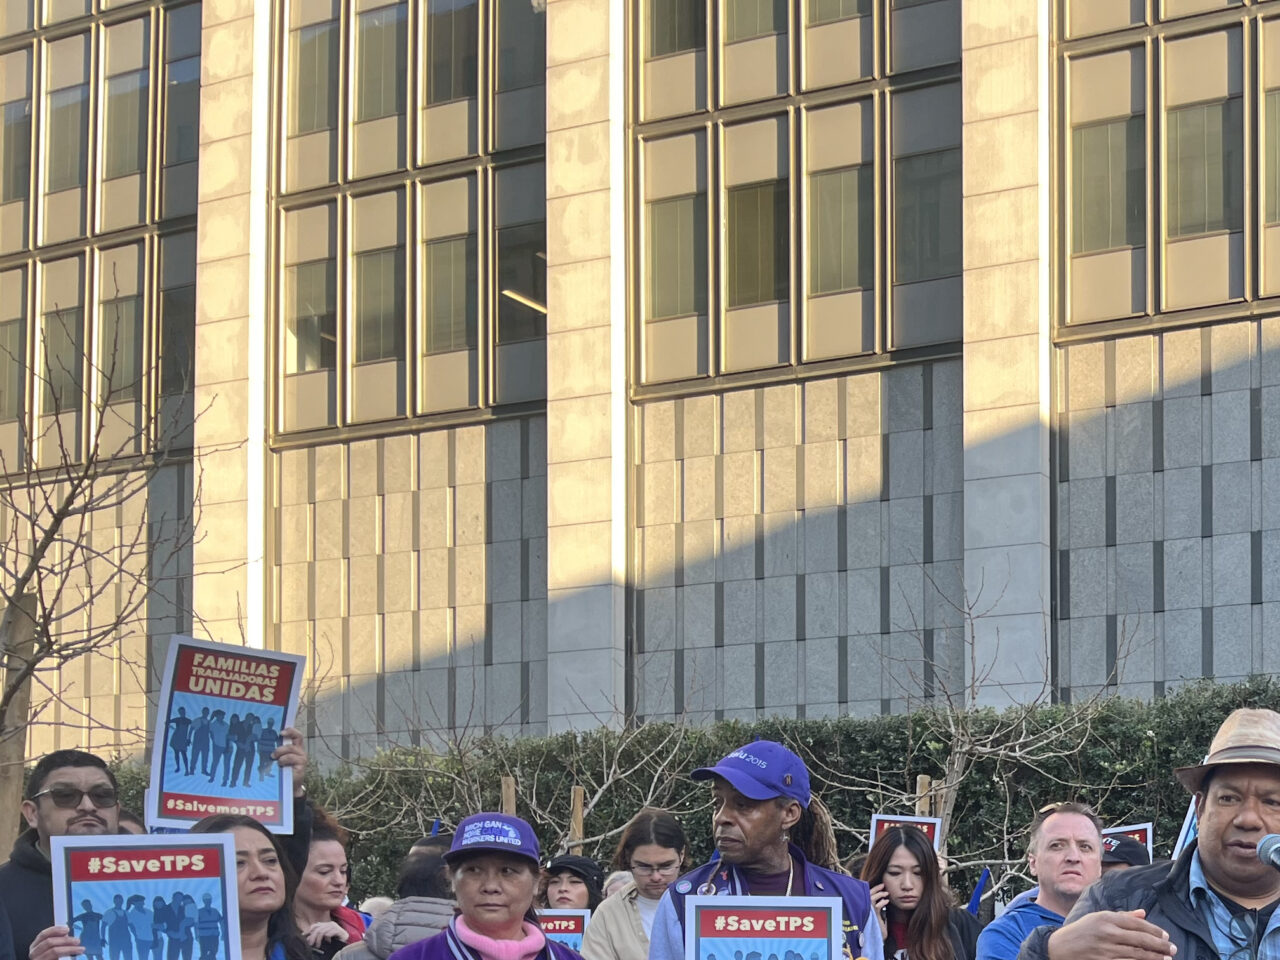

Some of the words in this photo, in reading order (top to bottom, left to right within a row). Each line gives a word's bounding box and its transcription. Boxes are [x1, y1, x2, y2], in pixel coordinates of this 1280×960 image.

[193, 653, 281, 678] FAMILIAS
[192, 666, 278, 687] TRABAJADORAS
[189, 677, 275, 702] UNIDAS
[745, 755, 768, 769] 2015
[167, 799, 275, 816] #SalvemosTPS
[496, 836, 521, 845] UNITED
[88, 854, 205, 874] #SaveTPS
[541, 920, 575, 930] veTPS
[714, 915, 814, 932] #SaveTPS
